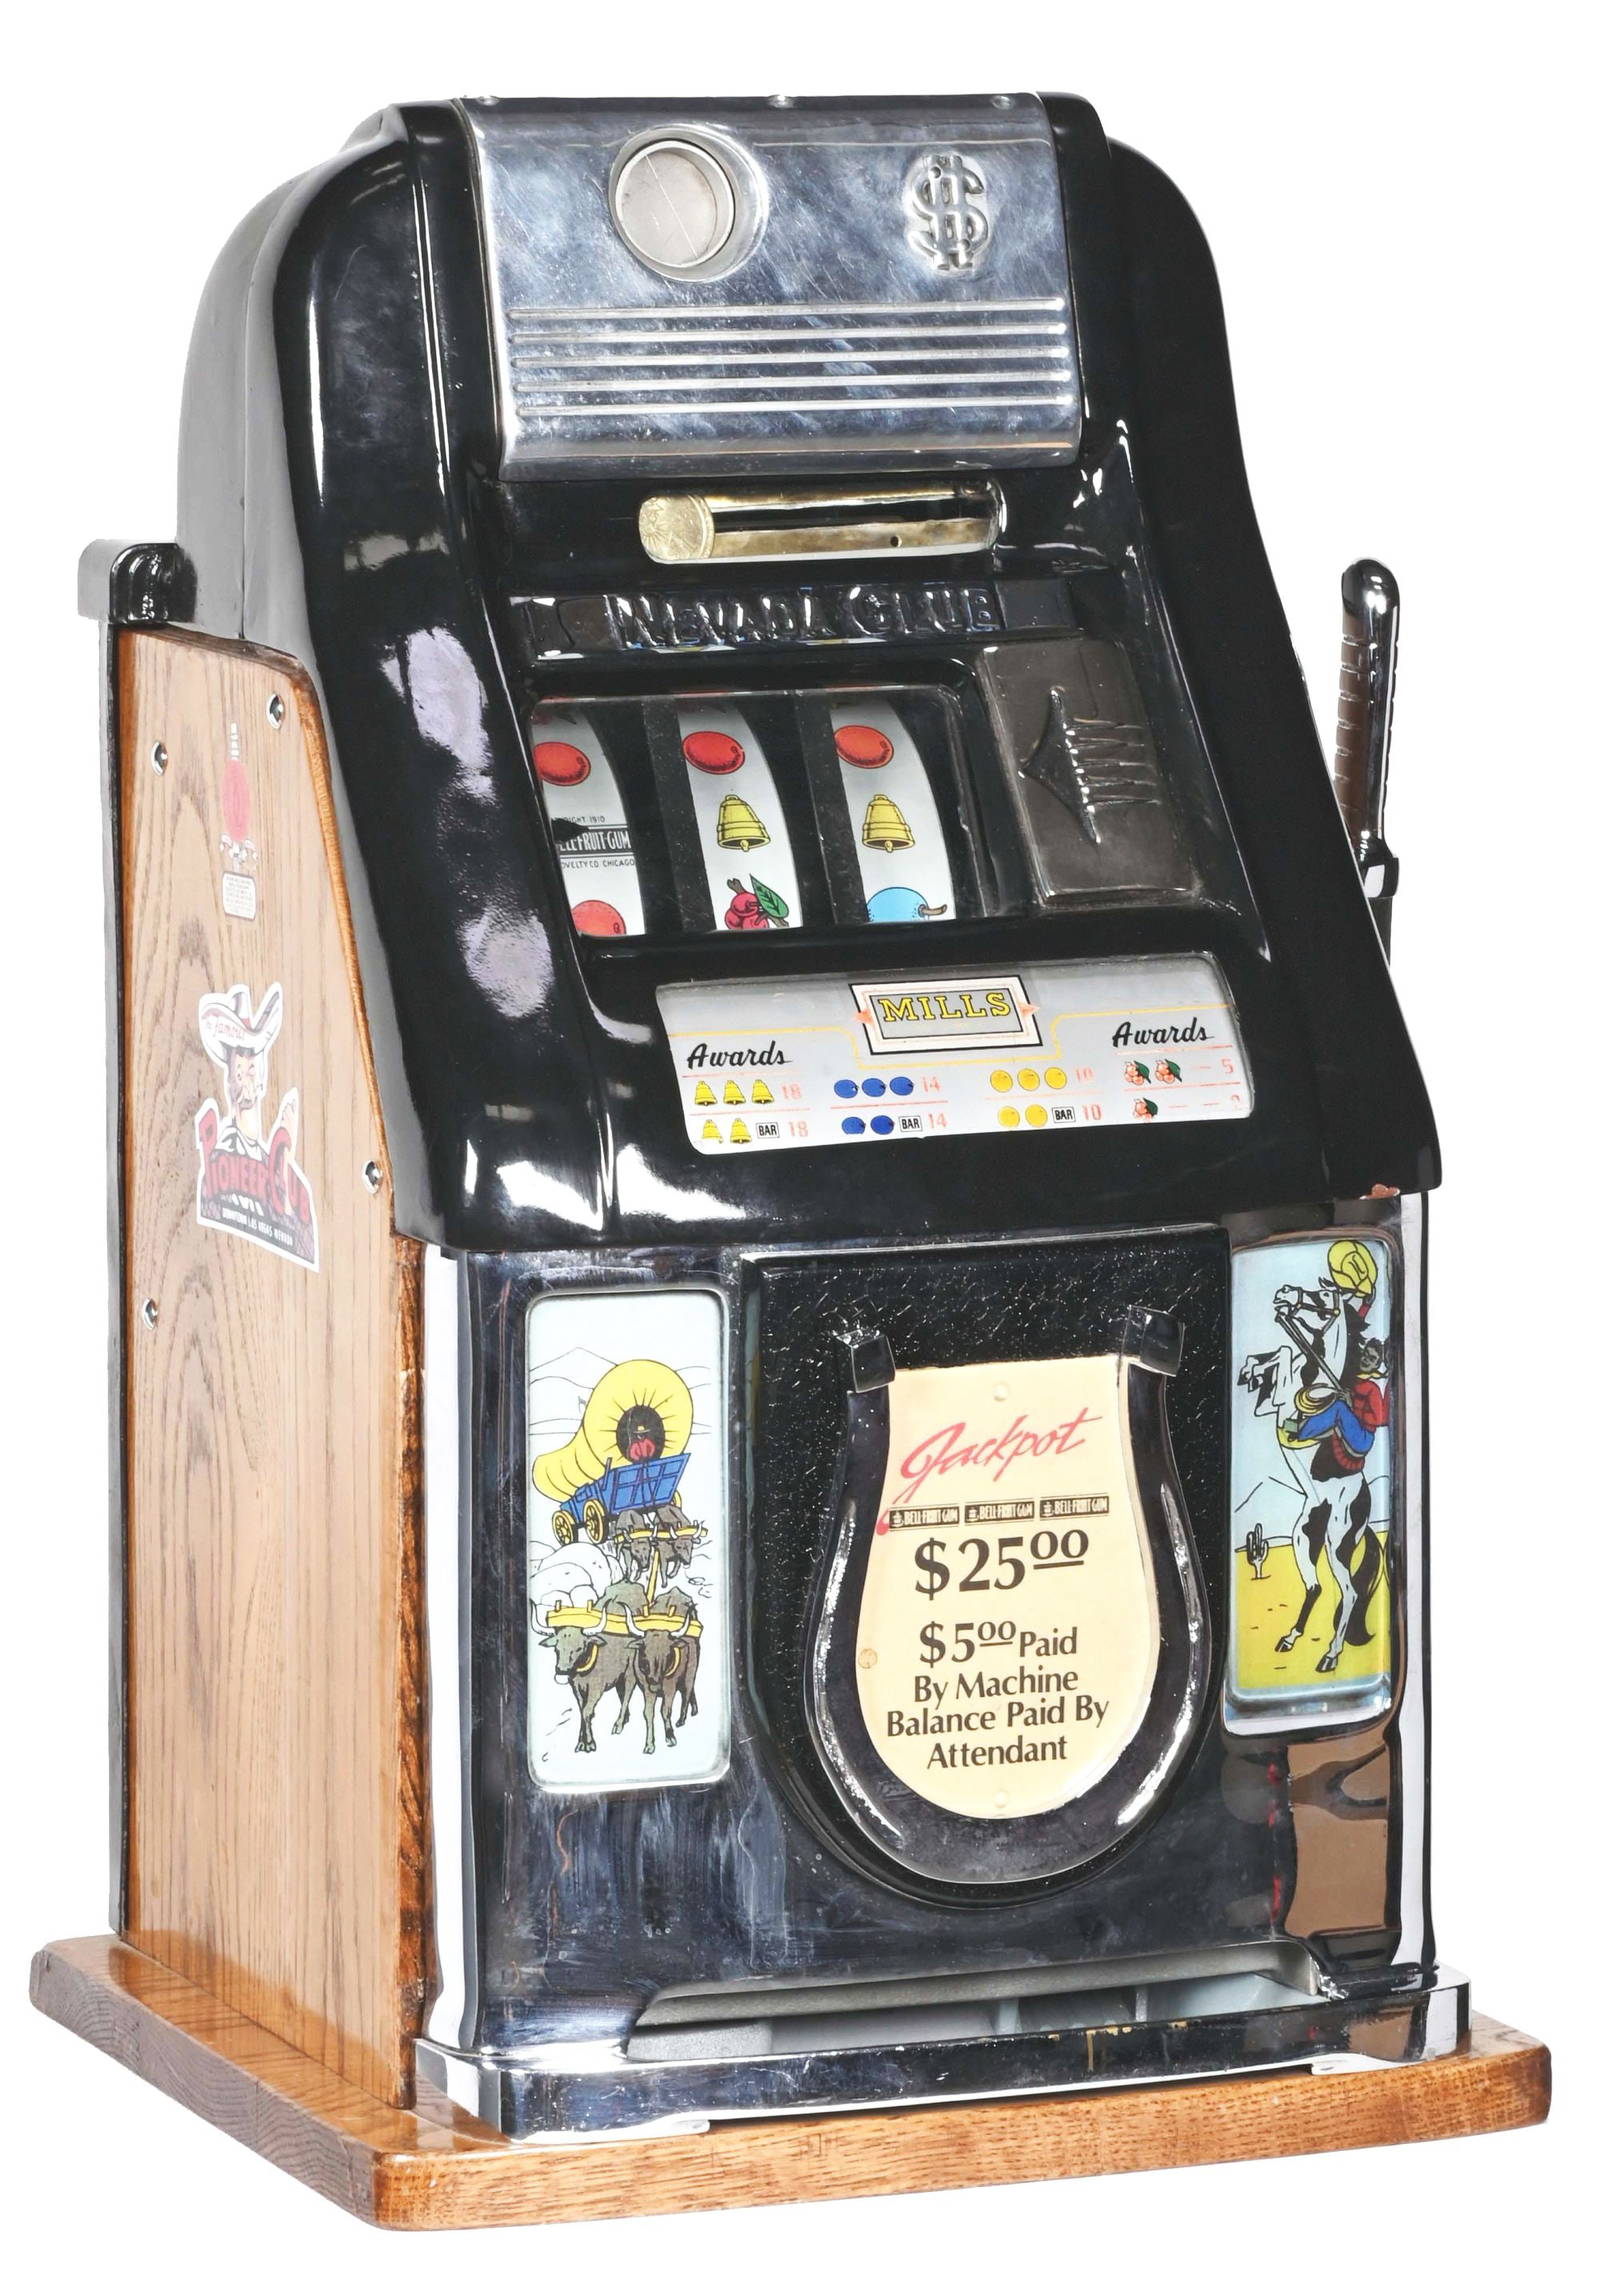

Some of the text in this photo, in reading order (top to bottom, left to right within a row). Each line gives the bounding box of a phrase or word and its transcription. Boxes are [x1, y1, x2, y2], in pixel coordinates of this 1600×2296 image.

[602, 585, 999, 649] NEVADA CLUB
[602, 858, 635, 867] CHICAGO
[878, 992, 1011, 1022] MILLS
[1112, 1017, 1214, 1048] Awards
[687, 1040, 792, 1070] Awards
[780, 1083, 803, 1100] 18
[920, 1076, 942, 1093] 14
[901, 1112, 948, 1130] BAR 14
[1054, 1103, 1102, 1121] BAR 10
[758, 1120, 809, 1138] BAR 18
[199, 1108, 270, 1201] PIONEER
[877, 1407, 1103, 1535] Jackpot
[1020, 1626, 1078, 1658] Paid
[914, 1664, 1079, 1710] By Machine
[887, 1694, 1110, 1738] Balance Paid By
[927, 1735, 1068, 1770] Attendant
